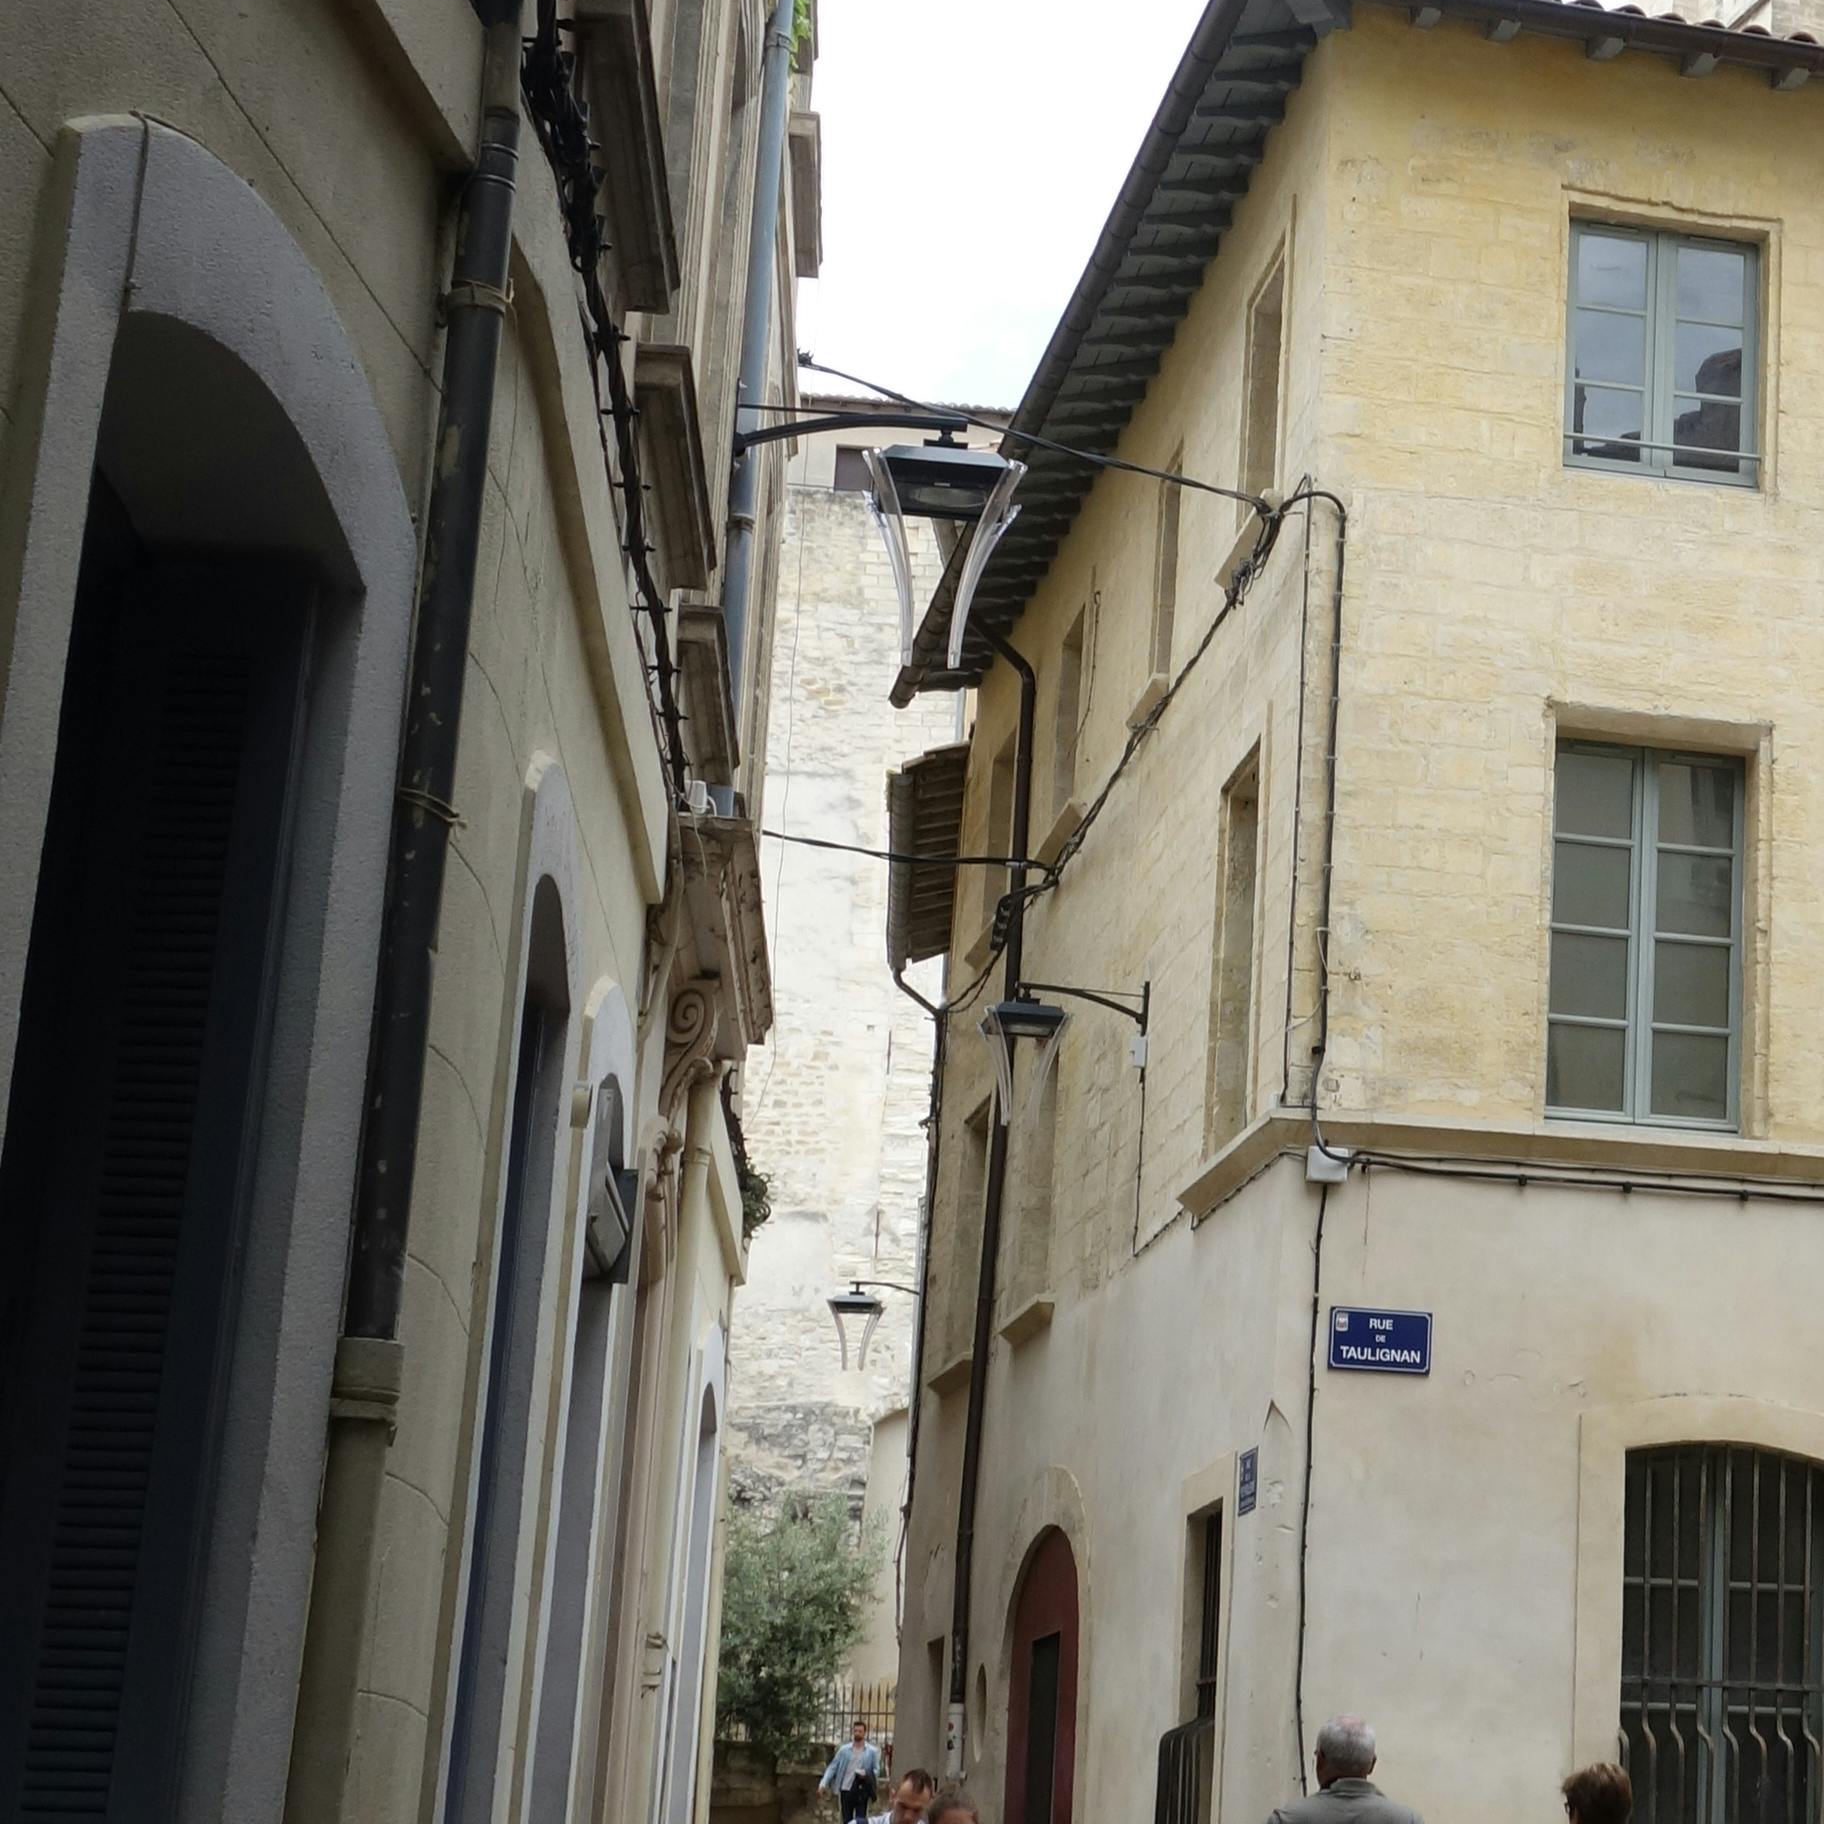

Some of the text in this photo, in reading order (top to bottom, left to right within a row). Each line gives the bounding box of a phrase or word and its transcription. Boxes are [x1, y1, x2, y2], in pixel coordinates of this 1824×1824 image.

[1369, 1318, 1393, 1330] RUE
[1375, 1334, 1386, 1343] DE
[1340, 1345, 1421, 1364] TAULIGNAN
